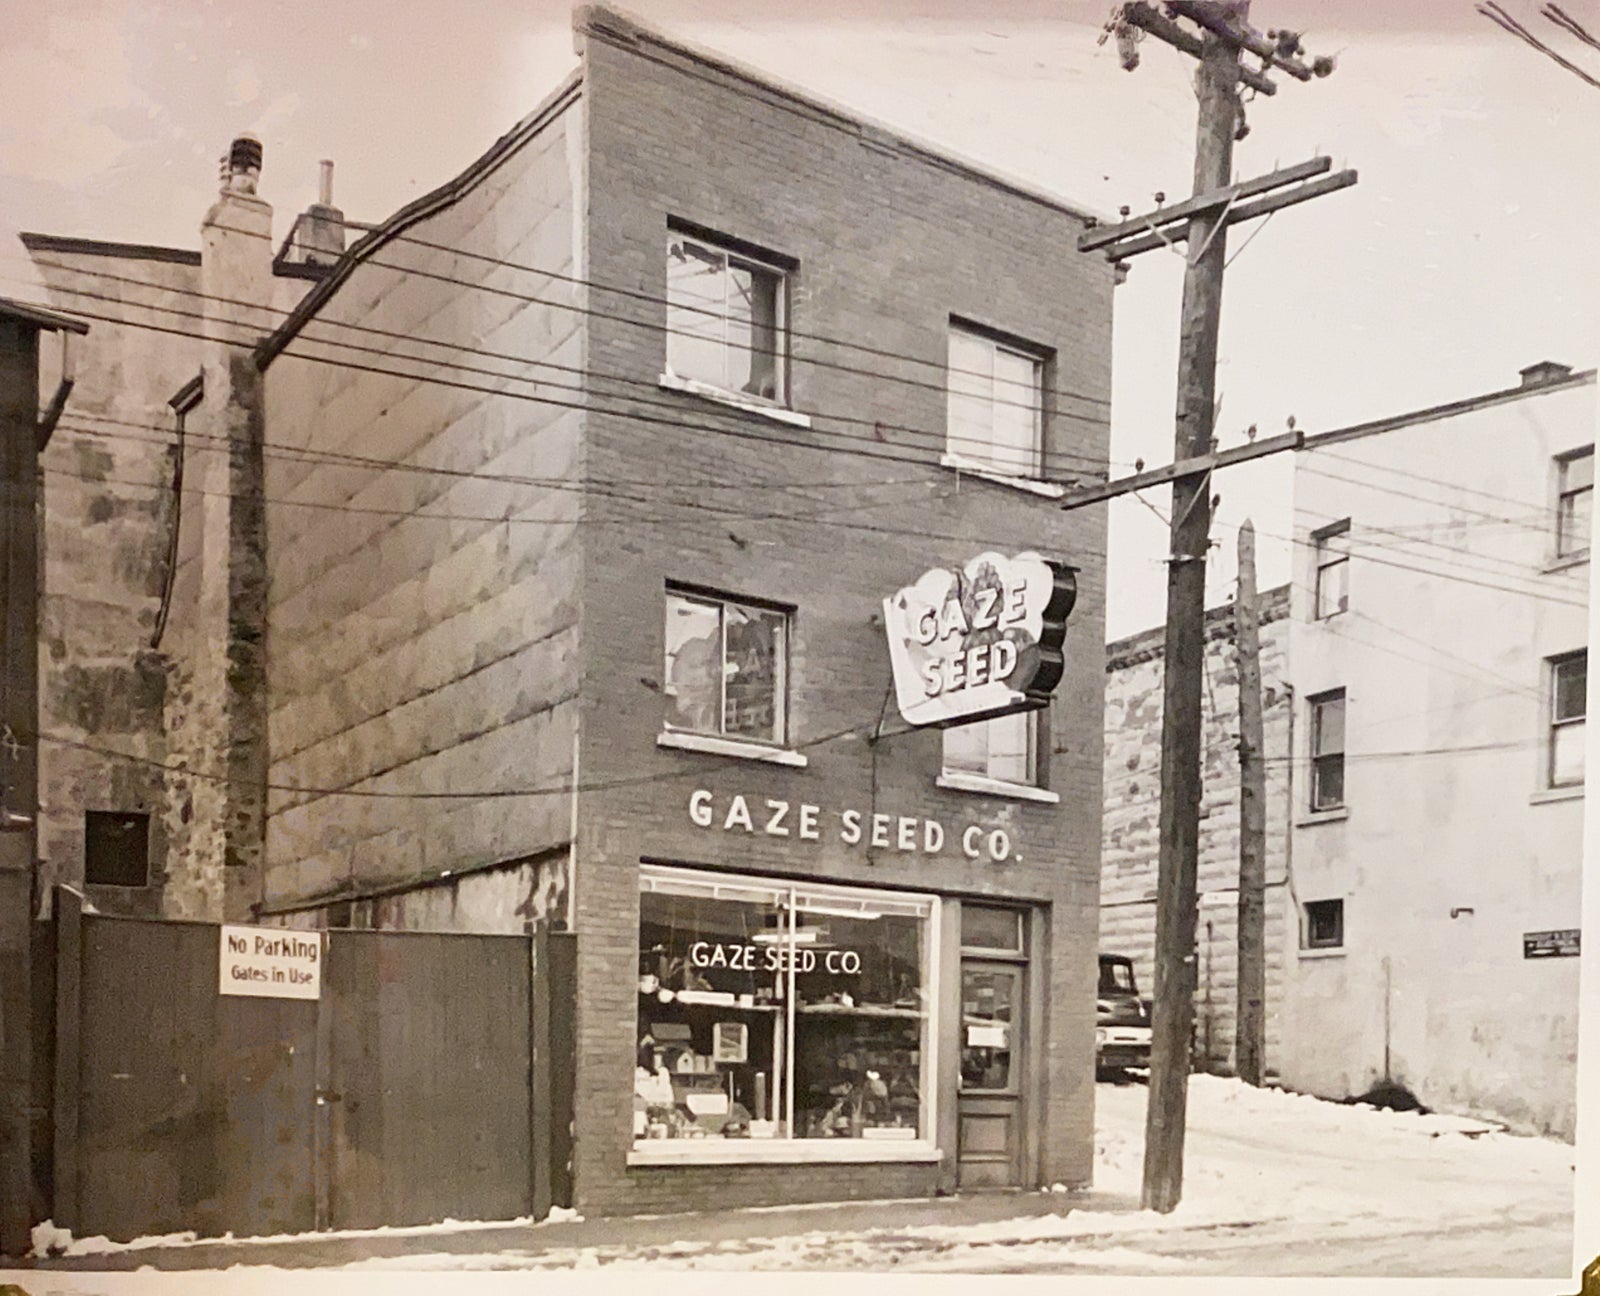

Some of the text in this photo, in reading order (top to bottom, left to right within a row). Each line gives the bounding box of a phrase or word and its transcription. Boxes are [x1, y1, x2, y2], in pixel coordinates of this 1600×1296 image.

[915, 578, 1027, 645] GAZE
[922, 639, 1017, 697] SEED
[689, 790, 1024, 862] GAZE SEED CO.
[255, 935, 317, 962] Parking
[691, 942, 863, 975] GAZE SEED CO.
[231, 964, 313, 985] Gates in Use
